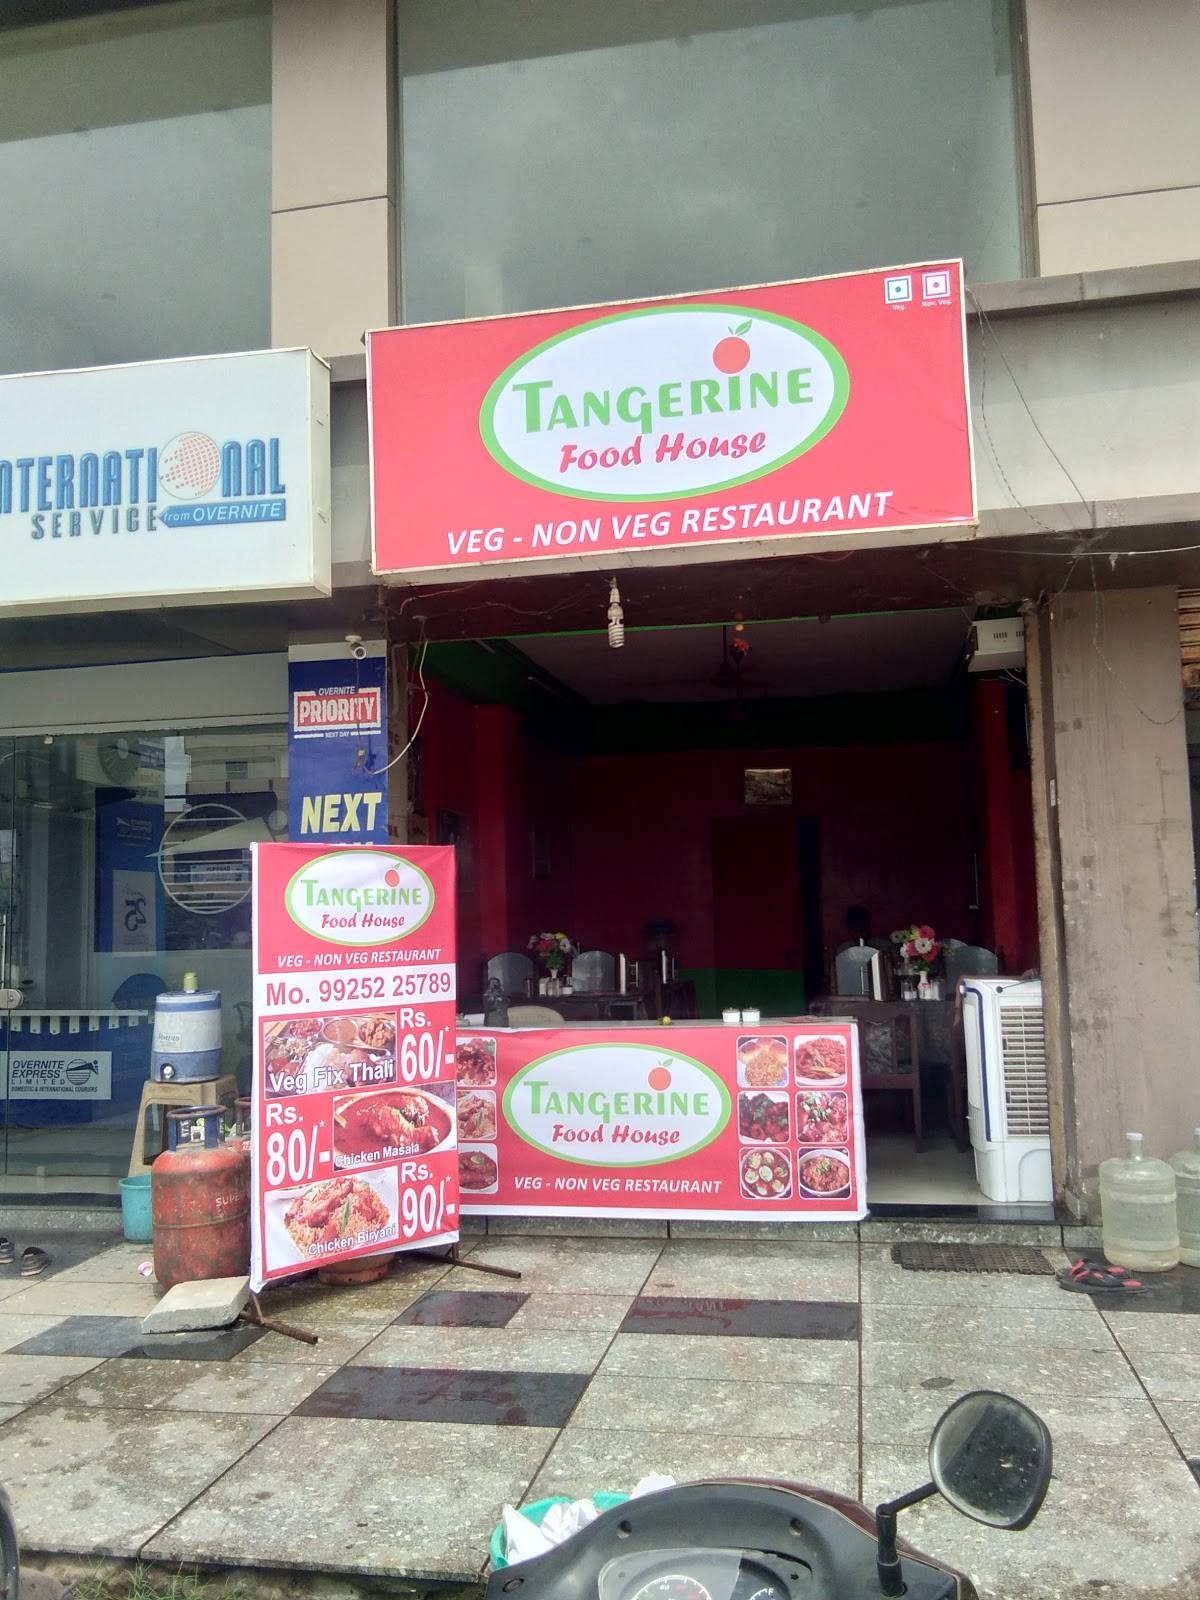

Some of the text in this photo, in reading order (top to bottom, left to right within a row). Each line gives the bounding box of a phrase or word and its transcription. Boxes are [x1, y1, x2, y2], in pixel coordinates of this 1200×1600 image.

[559, 431, 767, 474] Food House
[163, 511, 191, 523] from
[192, 503, 281, 523] OVERNITE
[446, 527, 504, 556] VEG
[531, 518, 600, 549] NON
[610, 511, 672, 541] VEG
[681, 491, 894, 535] RESTAURANT
[319, 686, 356, 696] OVERNITE
[300, 697, 375, 723] PRIORITY
[300, 792, 382, 834] NEXT
[321, 913, 405, 929] Food House
[277, 955, 303, 968] VEG
[314, 953, 342, 966] NON
[345, 952, 368, 964] VEG
[371, 948, 442, 963] RESTAURANT
[266, 972, 451, 1006] Mo. 99252 25789
[400, 1008, 431, 1028] Rs.
[11, 1069, 60, 1078] EXPRESS
[13, 1060, 65, 1069] OVERNITE
[270, 1060, 394, 1094] Veg Fix Thali
[265, 1103, 304, 1127] Rs.
[552, 1123, 680, 1145] Food House
[335, 1143, 420, 1168] Chicken Masala
[401, 1161, 433, 1184] Rs.
[514, 1176, 543, 1190] VEG
[554, 1177, 587, 1192] NON
[592, 1178, 621, 1192] VEG
[624, 1179, 723, 1194] RESTAURANT
[308, 1224, 396, 1256] Chicken Biryani
